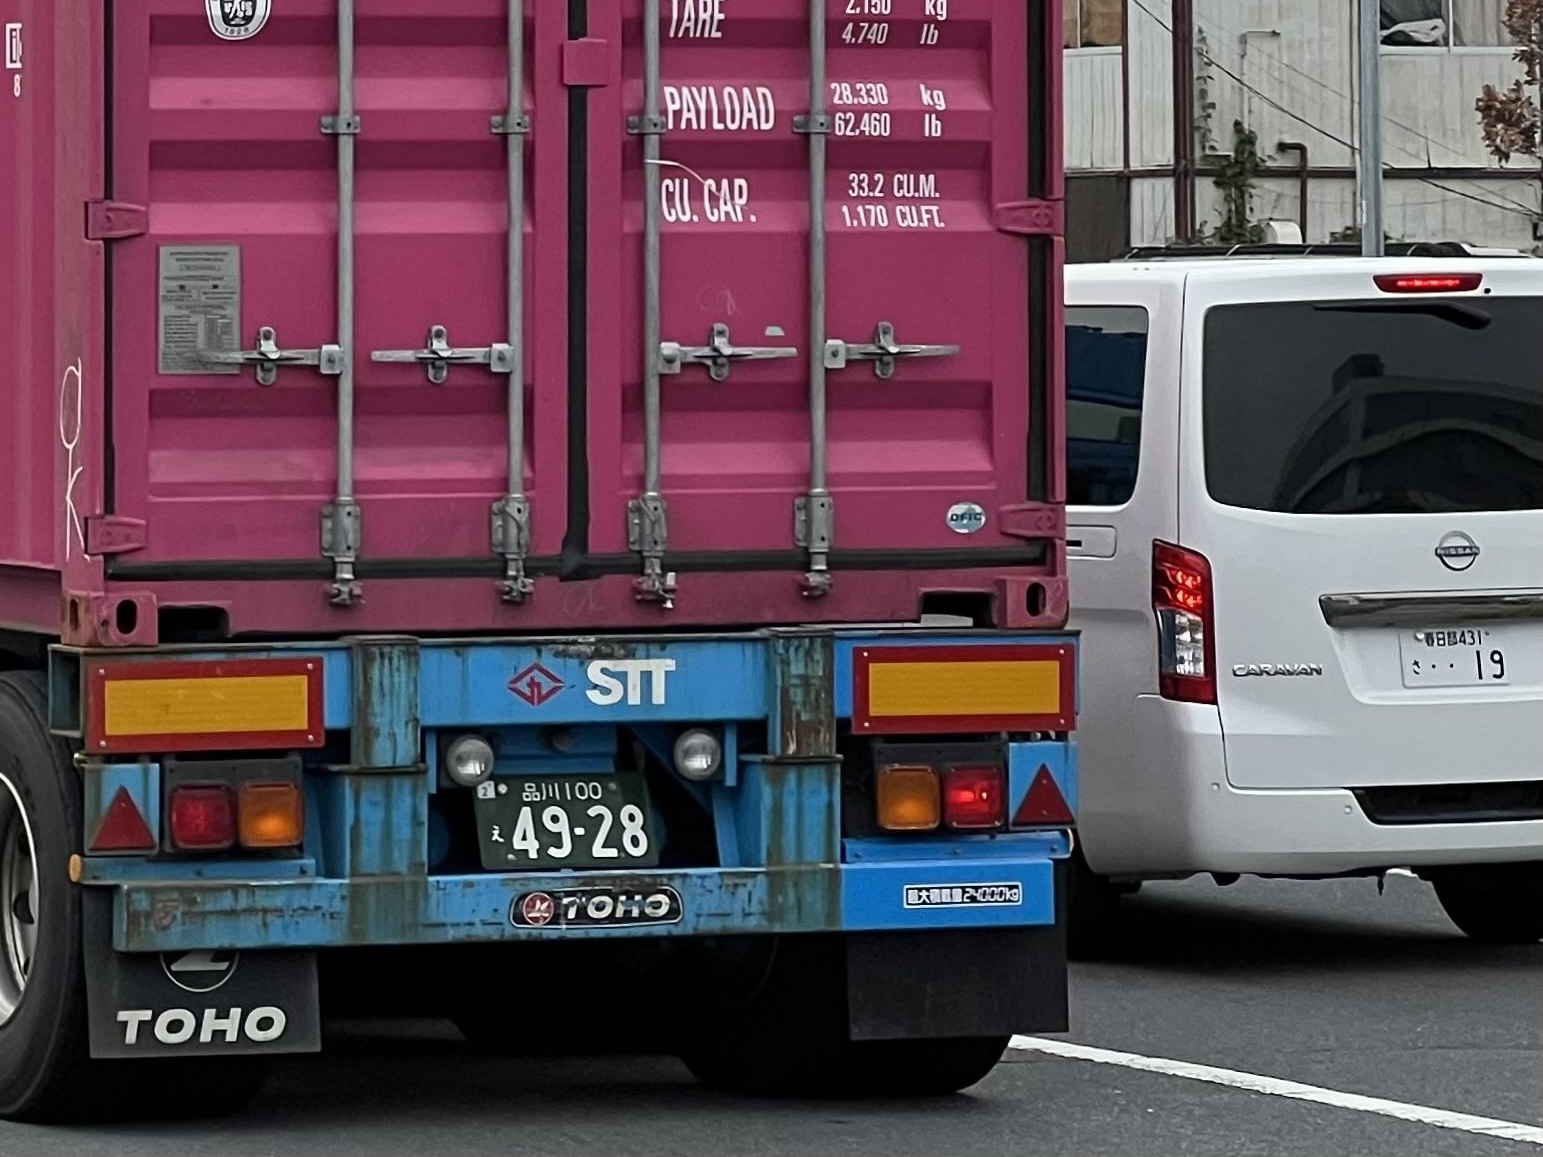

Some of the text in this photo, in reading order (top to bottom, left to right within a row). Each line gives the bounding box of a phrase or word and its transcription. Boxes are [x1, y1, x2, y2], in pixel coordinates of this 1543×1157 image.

[919, 24, 939, 45] lb
[663, 86, 775, 131] PAYLOAD
[919, 84, 946, 111] kg
[924, 113, 942, 137] lb
[660, 173, 941, 223] CU. CAP. 33.2 CU.M.
[586, 658, 676, 706] STT
[1232, 663, 1323, 677] CARAVAN
[492, 804, 648, 859] え 49-28
[561, 894, 671, 920] TOHO
[116, 1006, 287, 1045] TOHO
